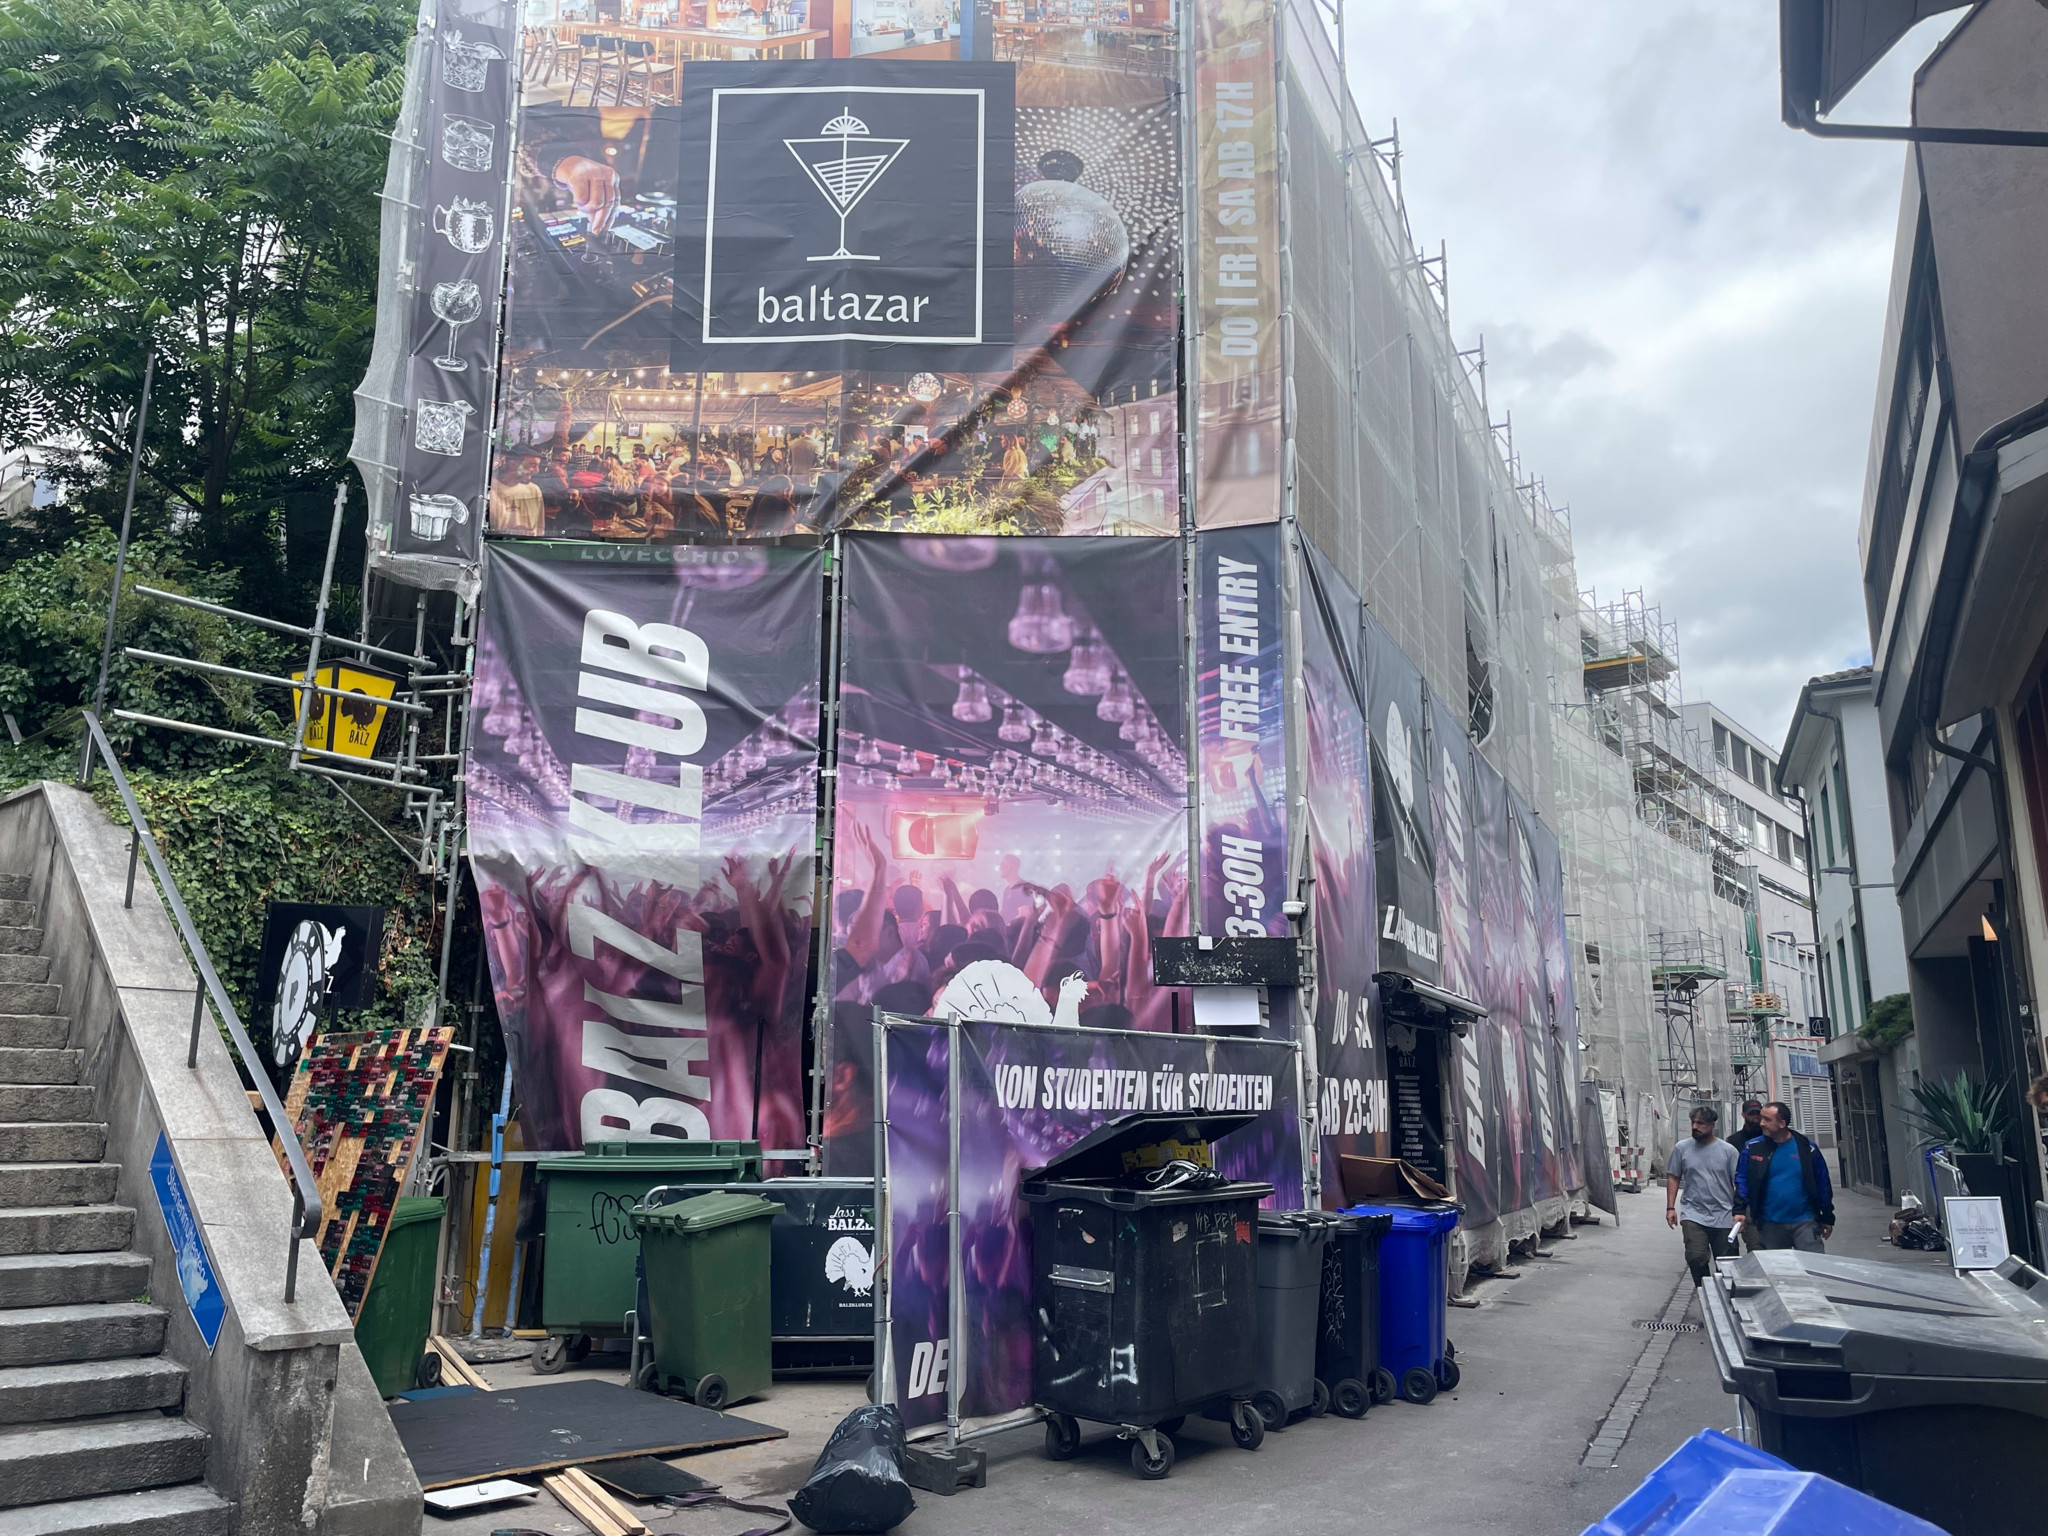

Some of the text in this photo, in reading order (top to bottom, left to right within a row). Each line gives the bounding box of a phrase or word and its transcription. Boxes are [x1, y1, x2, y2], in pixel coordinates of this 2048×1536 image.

[1216, 81, 1253, 133] 17H
[1218, 140, 1255, 179] AB
[1218, 188, 1256, 226] SA
[1219, 254, 1257, 287] FR
[758, 284, 929, 324] baltazar
[1220, 316, 1258, 356] DO
[580, 548, 740, 564] LOVECCHIO
[1218, 555, 1259, 742] FREE ENTRY
[309, 726, 324, 741] BALZ
[348, 729, 370, 746] BALZ
[567, 609, 711, 1146] BALZ KLUB
[1220, 834, 1267, 938] 3:30H
[1332, 989, 1349, 1046] DO
[1354, 996, 1374, 1049] SA
[995, 1064, 1038, 1109] VON
[1042, 1067, 1148, 1110] STUDENTEN
[1152, 1064, 1184, 1110] FÜR
[1320, 1077, 1341, 1136] AB
[1343, 1078, 1388, 1135] 23:30H
[827, 1218, 875, 1231] BALZ
[829, 1206, 856, 1219] Lass
[908, 1338, 951, 1399] DE
